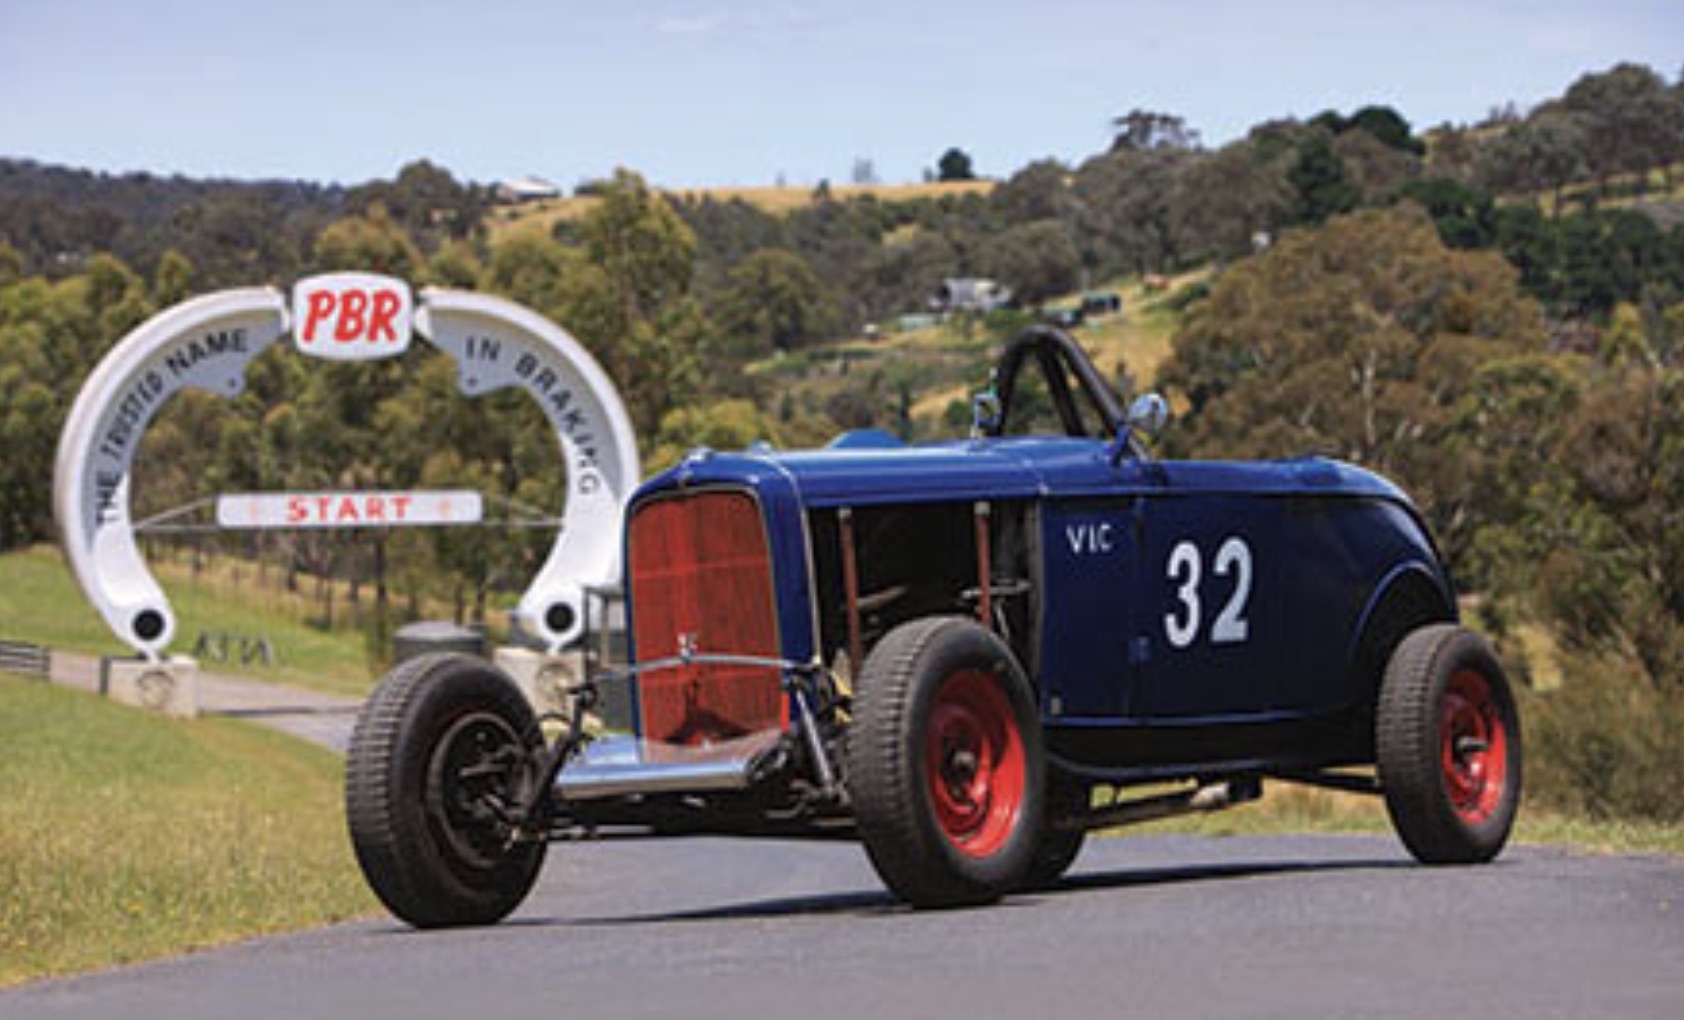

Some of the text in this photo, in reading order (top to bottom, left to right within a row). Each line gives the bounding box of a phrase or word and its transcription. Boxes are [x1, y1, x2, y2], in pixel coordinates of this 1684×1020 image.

[303, 288, 401, 343] PBR
[95, 328, 248, 524] THE TRUSTED NAME
[466, 334, 599, 495] IN BRAKING
[287, 494, 412, 522] START
[1066, 523, 1112, 553] VIC
[1165, 536, 1253, 647] 32
